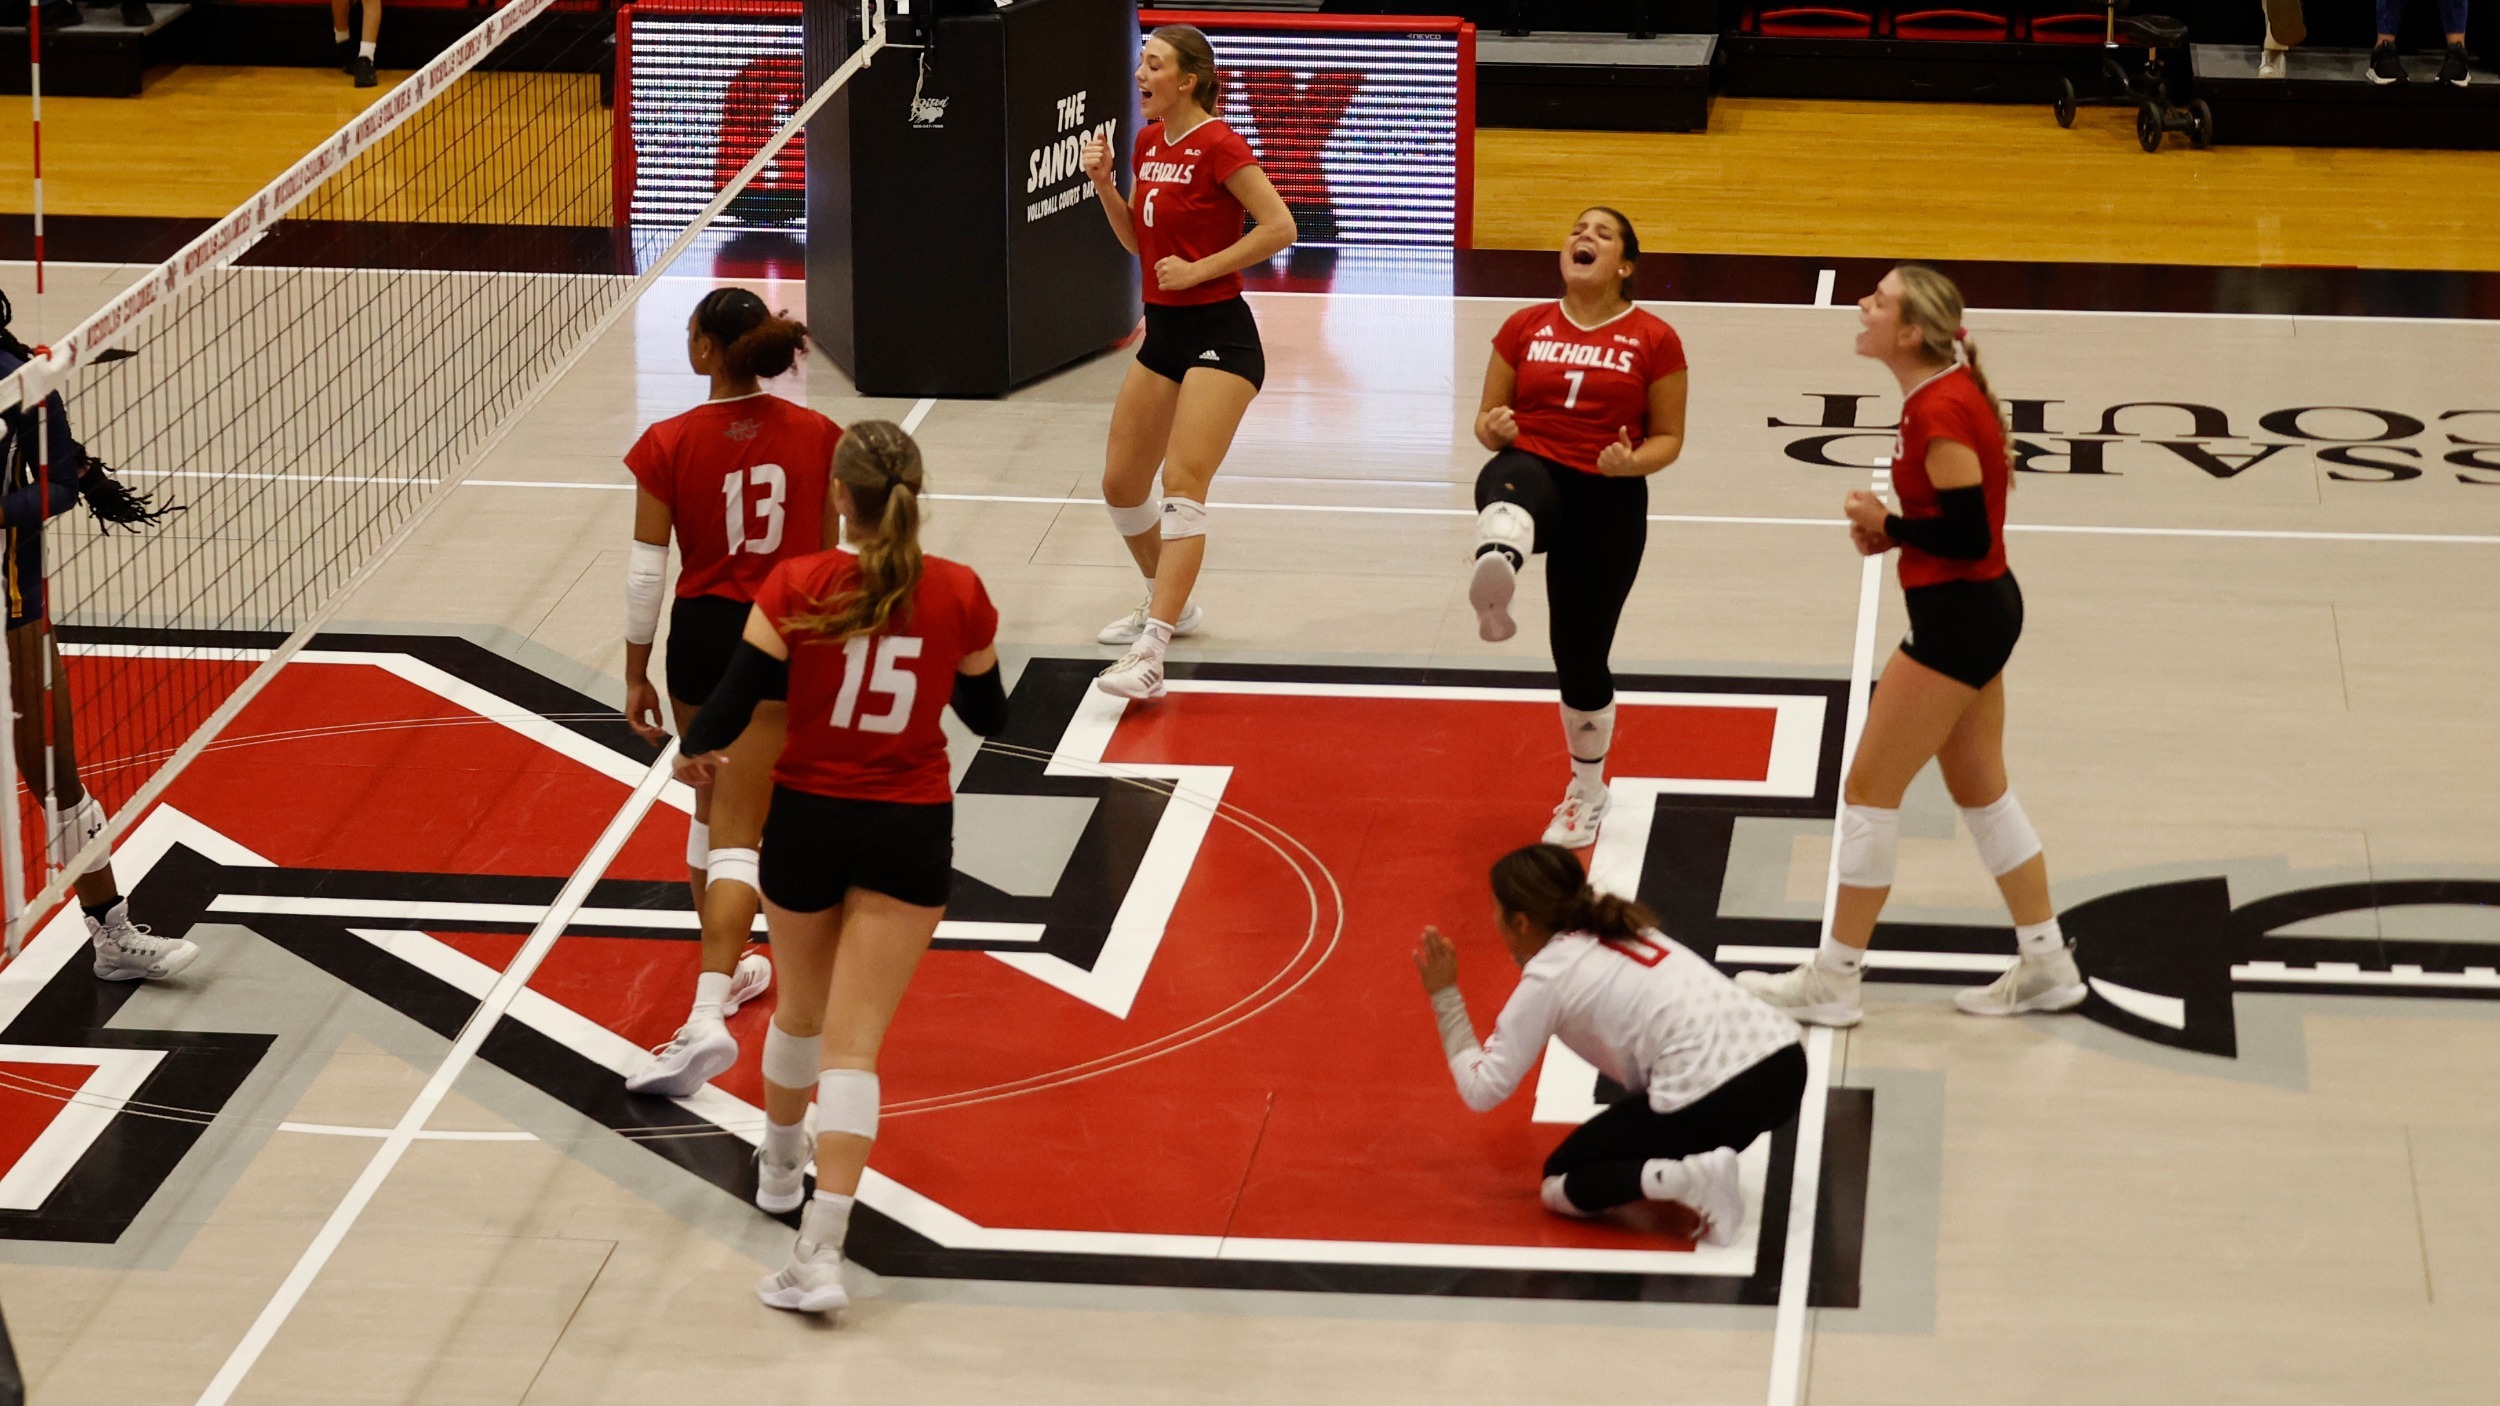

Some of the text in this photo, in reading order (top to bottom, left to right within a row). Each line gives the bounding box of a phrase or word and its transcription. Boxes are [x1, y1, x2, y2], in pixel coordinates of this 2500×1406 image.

[1057, 90, 1087, 133] THE
[1027, 118, 1117, 193] SANDX
[1058, 185, 1081, 210] COURTS
[1082, 180, 1095, 200] BAR
[1143, 188, 1159, 228] 6
[1526, 340, 1634, 374] NICHOLLS
[1563, 370, 1585, 409] 7
[722, 463, 787, 556] 13
[829, 636, 925, 735] 15
